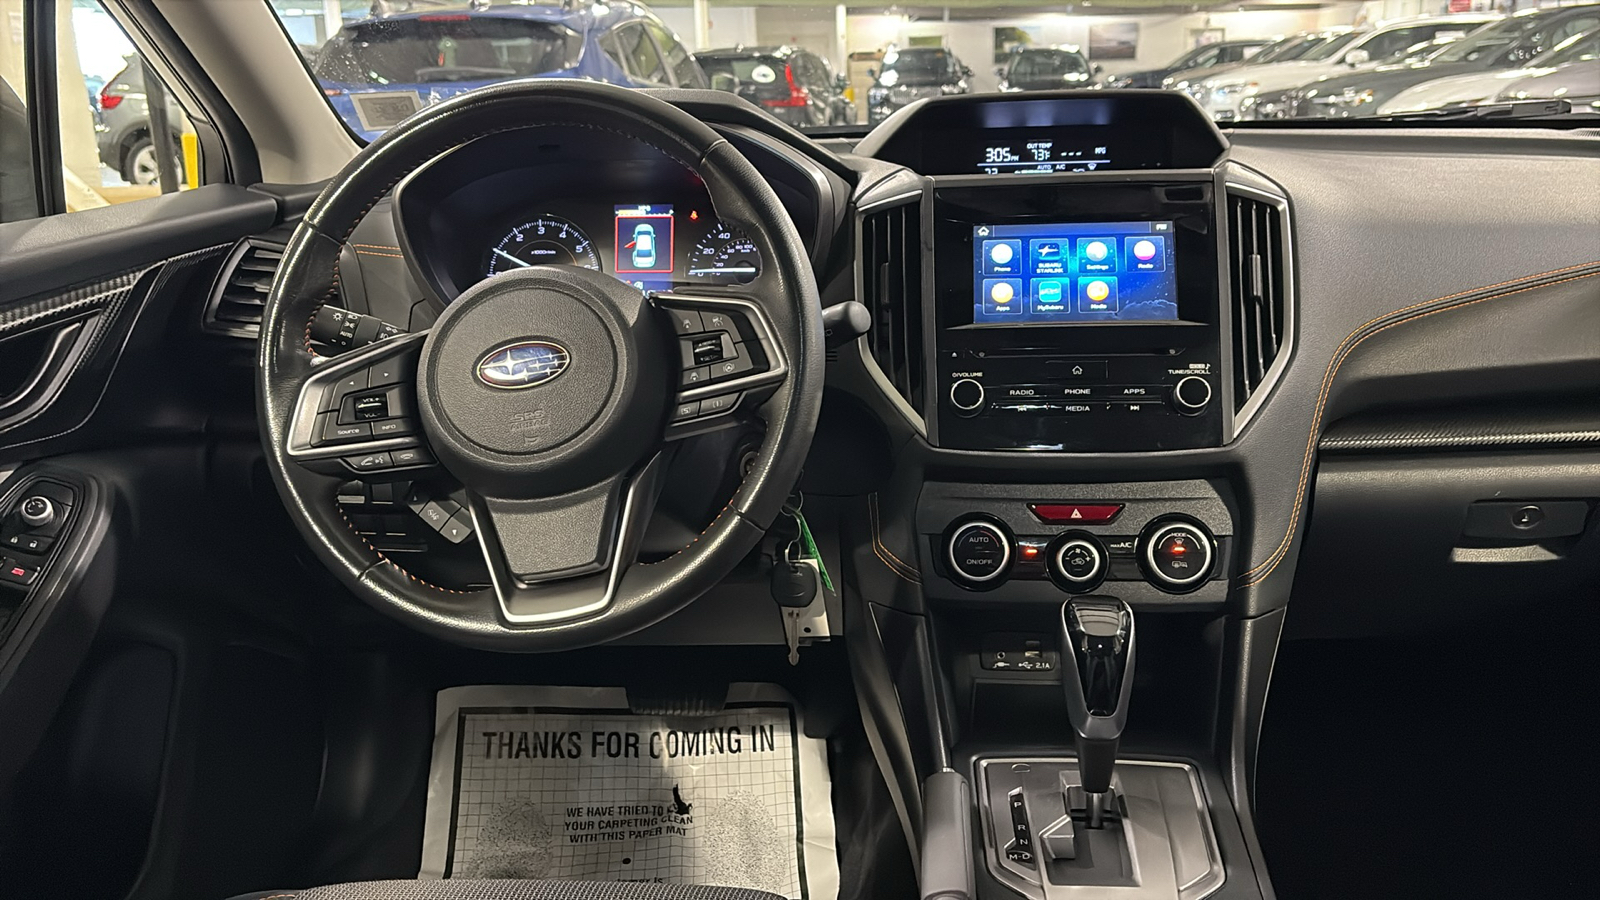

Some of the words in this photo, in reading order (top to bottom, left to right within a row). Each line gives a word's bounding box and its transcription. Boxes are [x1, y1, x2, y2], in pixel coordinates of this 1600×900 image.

[985, 147, 1011, 162] 3:05
[538, 227, 545, 235] 3
[559, 231, 567, 239] 4
[516, 234, 524, 242] 2
[575, 245, 583, 253] 5
[340, 331, 353, 339] AUTO
[482, 731, 582, 760] THANKS
[591, 731, 640, 759] FOR
[650, 726, 742, 759] COMING
[752, 724, 775, 752] IN
[566, 807, 583, 818] WE
[586, 806, 614, 817] HAVE
[618, 805, 649, 816] TRIED
[652, 805, 664, 817] TO
[565, 820, 595, 831] YOUR
[598, 817, 658, 830] CARPETING
[661, 815, 693, 826] CLEAN
[569, 834, 598, 843] WITH
[601, 831, 625, 841] THIS
[628, 827, 662, 839] PAPER
[666, 825, 687, 837] MAT
